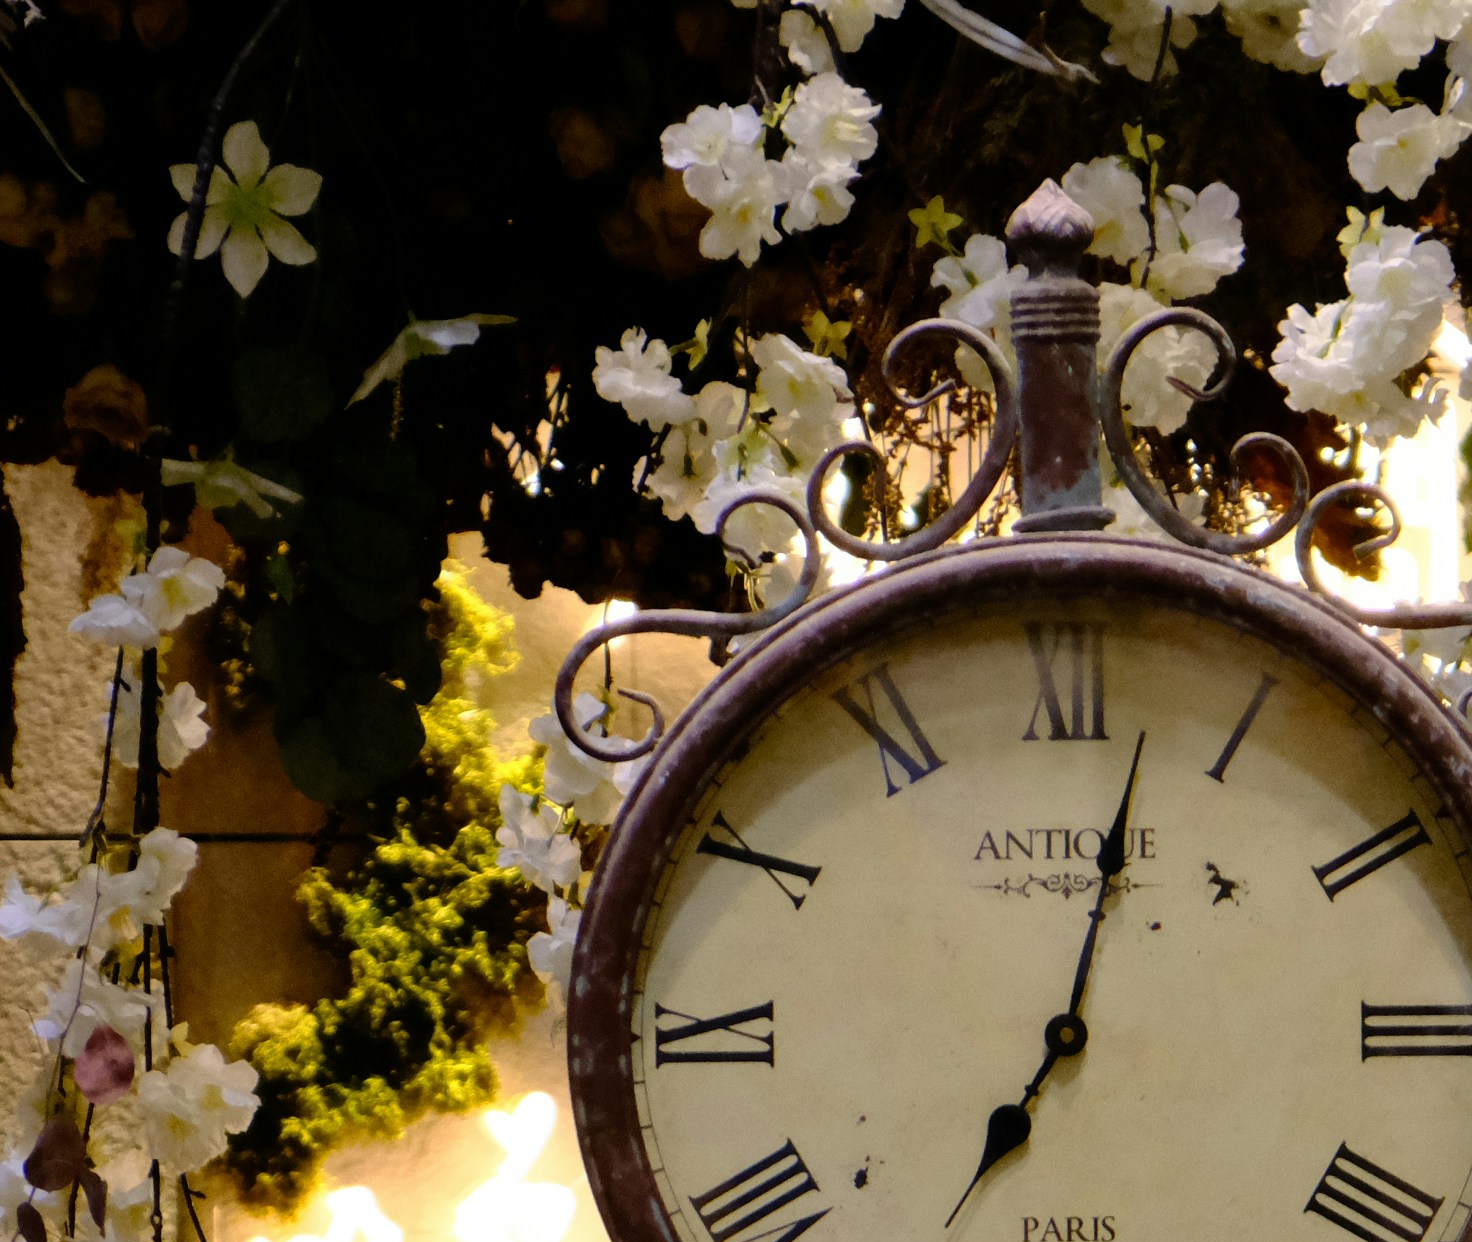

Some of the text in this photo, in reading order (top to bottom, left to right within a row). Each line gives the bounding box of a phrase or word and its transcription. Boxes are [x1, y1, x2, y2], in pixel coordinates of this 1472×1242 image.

[830, 660, 947, 798] XI
[1022, 621, 1110, 741] XII
[1204, 671, 1280, 783] I
[696, 809, 823, 910] X
[1310, 808, 1434, 902] II
[654, 1000, 775, 1069] IX
[1021, 1215, 1116, 1242] PARIS
